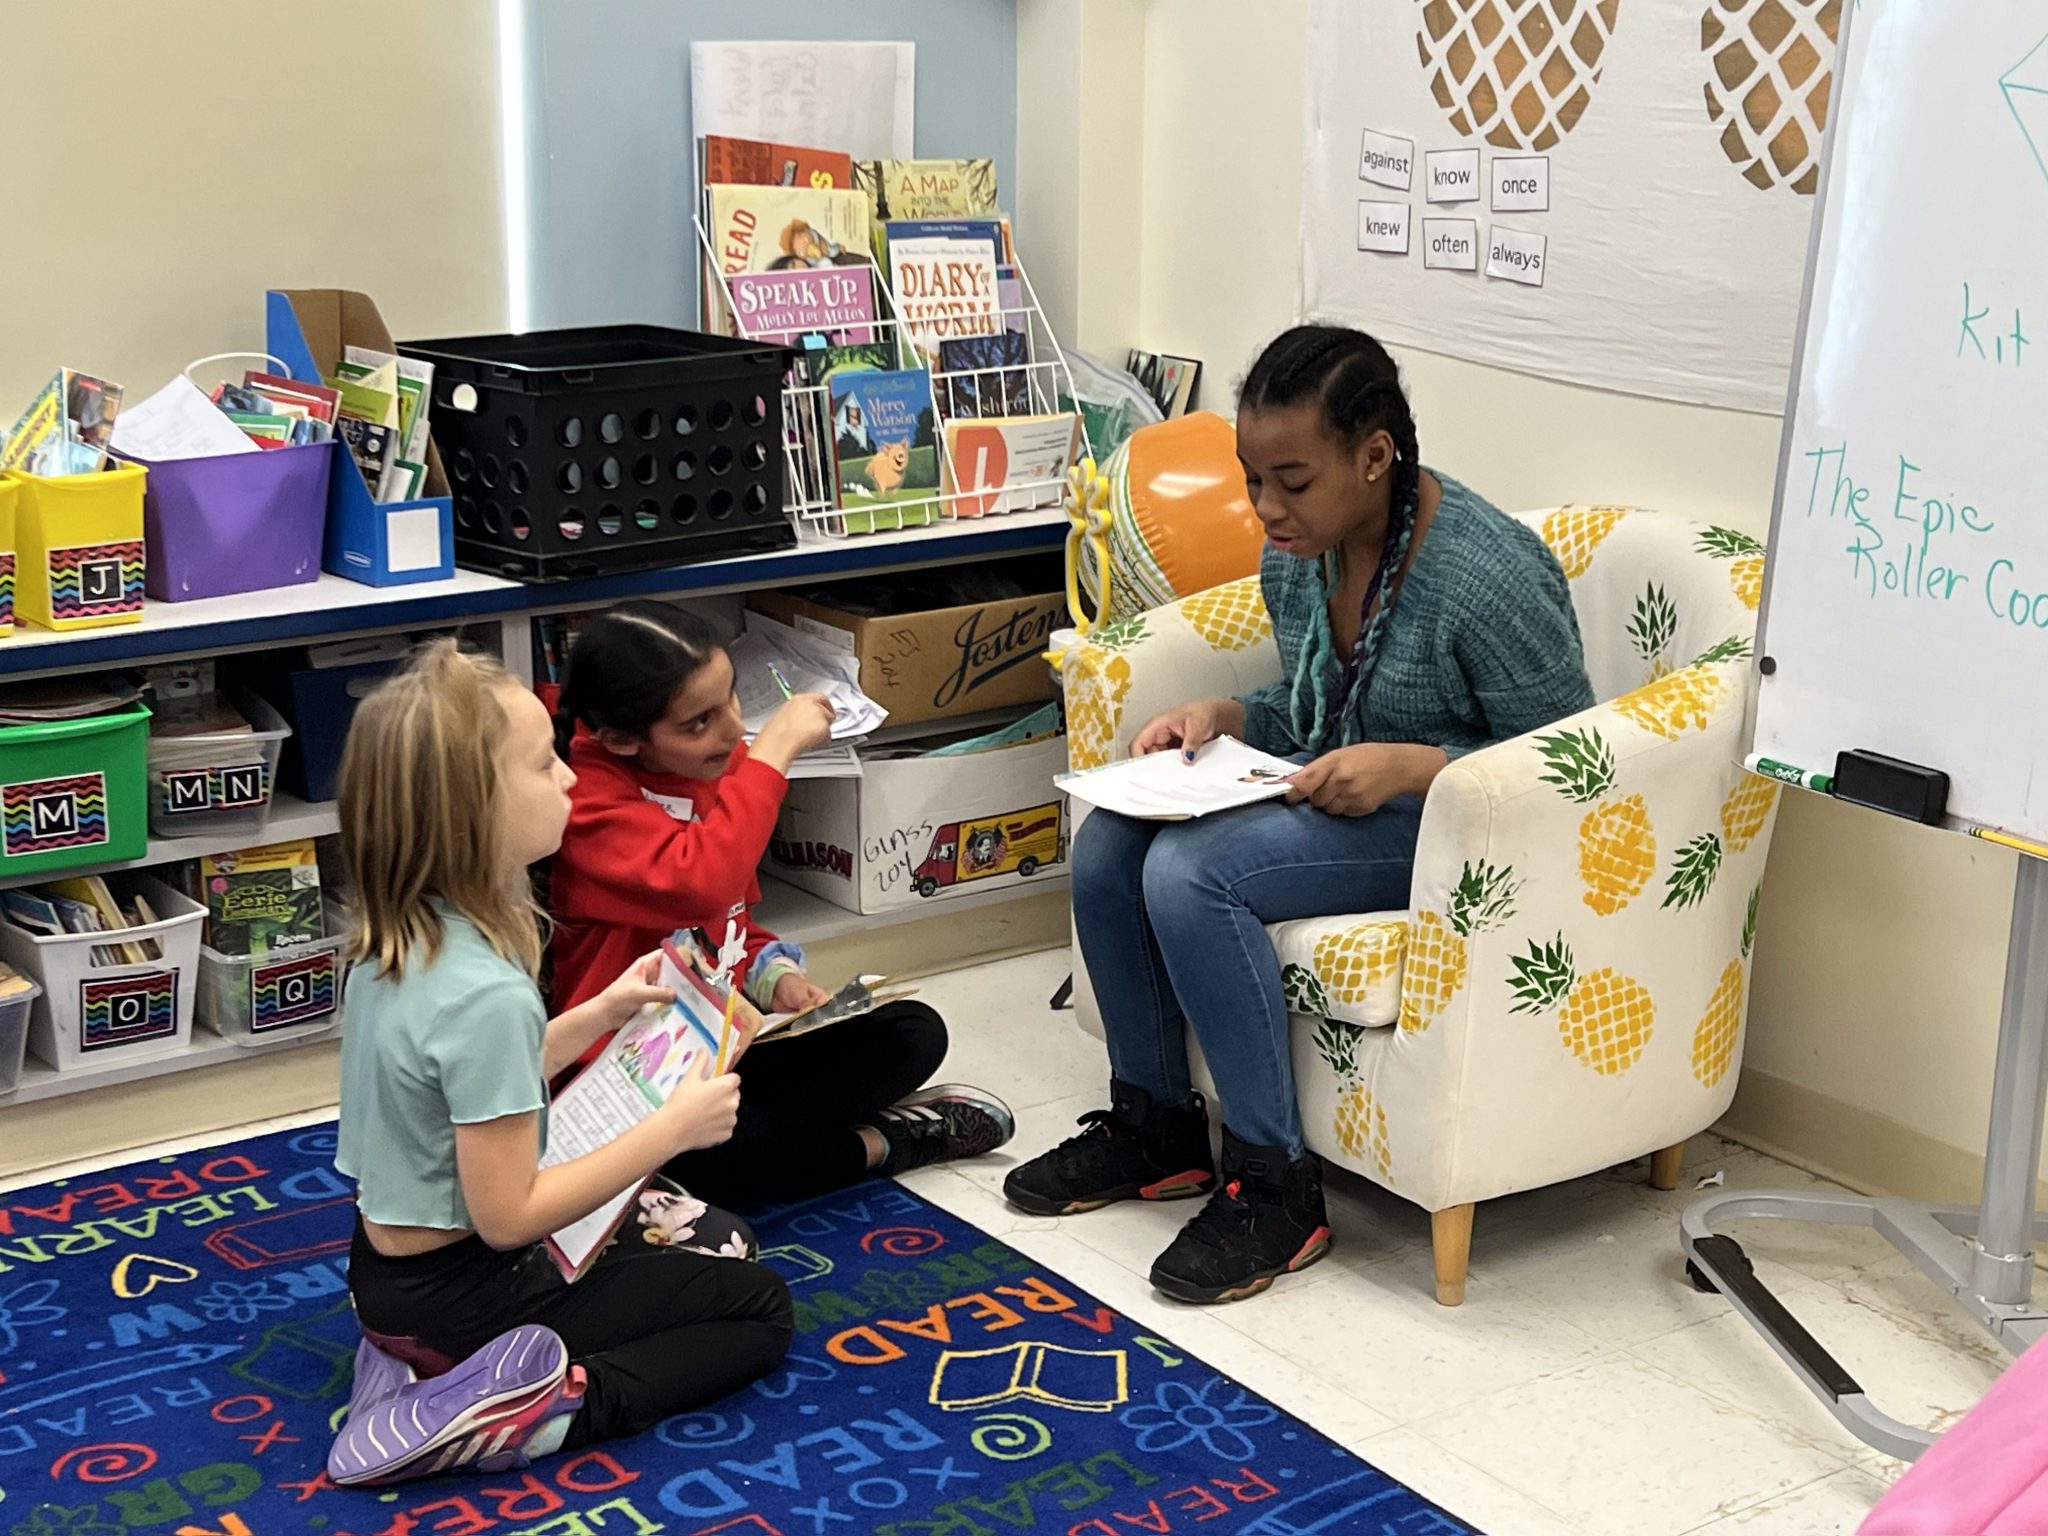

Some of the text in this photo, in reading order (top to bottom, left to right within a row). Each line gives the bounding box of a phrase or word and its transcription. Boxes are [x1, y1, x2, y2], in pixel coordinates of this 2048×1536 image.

[1363, 149, 1409, 174] against
[1433, 166, 1471, 186] know
[900, 174, 960, 195] A MAP
[1501, 177, 1538, 195] once
[1365, 216, 1401, 236] knew
[724, 208, 757, 275] READ
[1432, 233, 1470, 254] often
[1491, 243, 1541, 272] always
[899, 261, 983, 298] DIARY
[739, 277, 819, 314] SPEAK
[755, 307, 866, 332] MOLLY LOU MELON
[903, 301, 996, 337] WORM
[867, 397, 906, 416] Mercy
[870, 412, 918, 428] Watson
[1804, 440, 1995, 557] The Epic
[1845, 521, 1970, 600] Roller
[90, 565, 113, 595] J
[174, 774, 252, 804] M N
[37, 798, 72, 831] M
[223, 891, 288, 909] Eerie
[285, 978, 306, 1003] Q
[0, 1155, 272, 1236] DREA
[825, 1276, 1079, 1366] READ
[657, 1407, 946, 1518] READ
